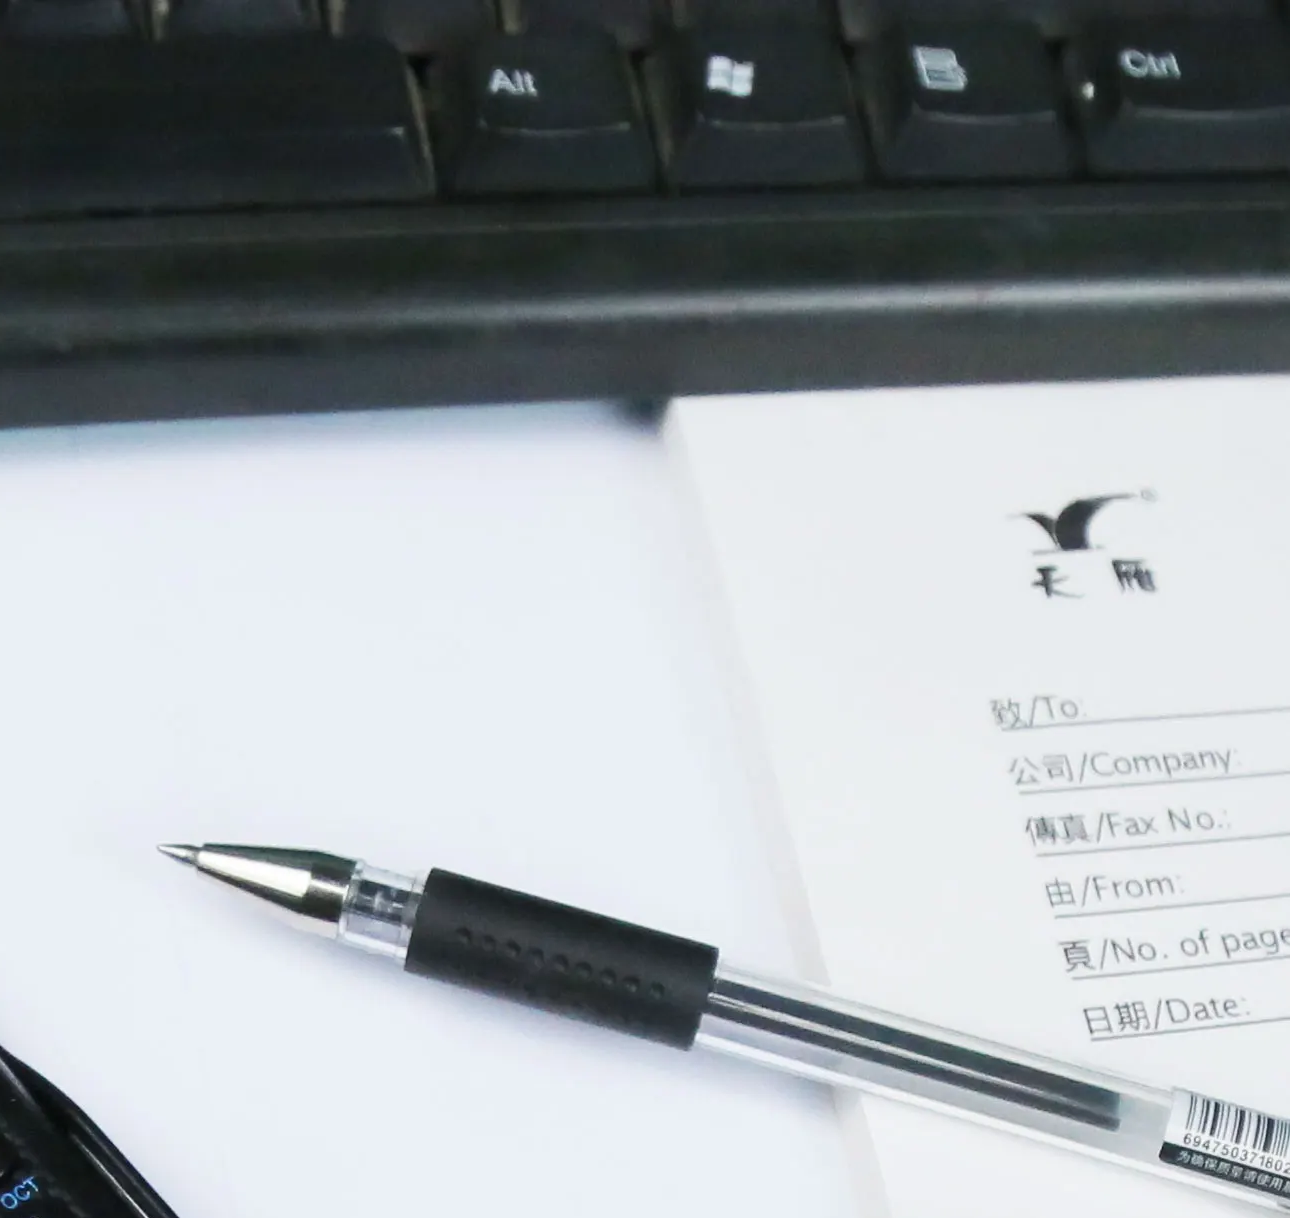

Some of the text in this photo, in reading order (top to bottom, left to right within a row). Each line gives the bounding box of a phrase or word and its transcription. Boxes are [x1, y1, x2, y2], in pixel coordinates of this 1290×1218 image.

[1120, 49, 1181, 80] Ctrl
[489, 67, 539, 97] Alt
[1180, 929, 1209, 958] of
[1083, 997, 1251, 1035] 日期/Date:
[0, 1176, 39, 1211] OCT
